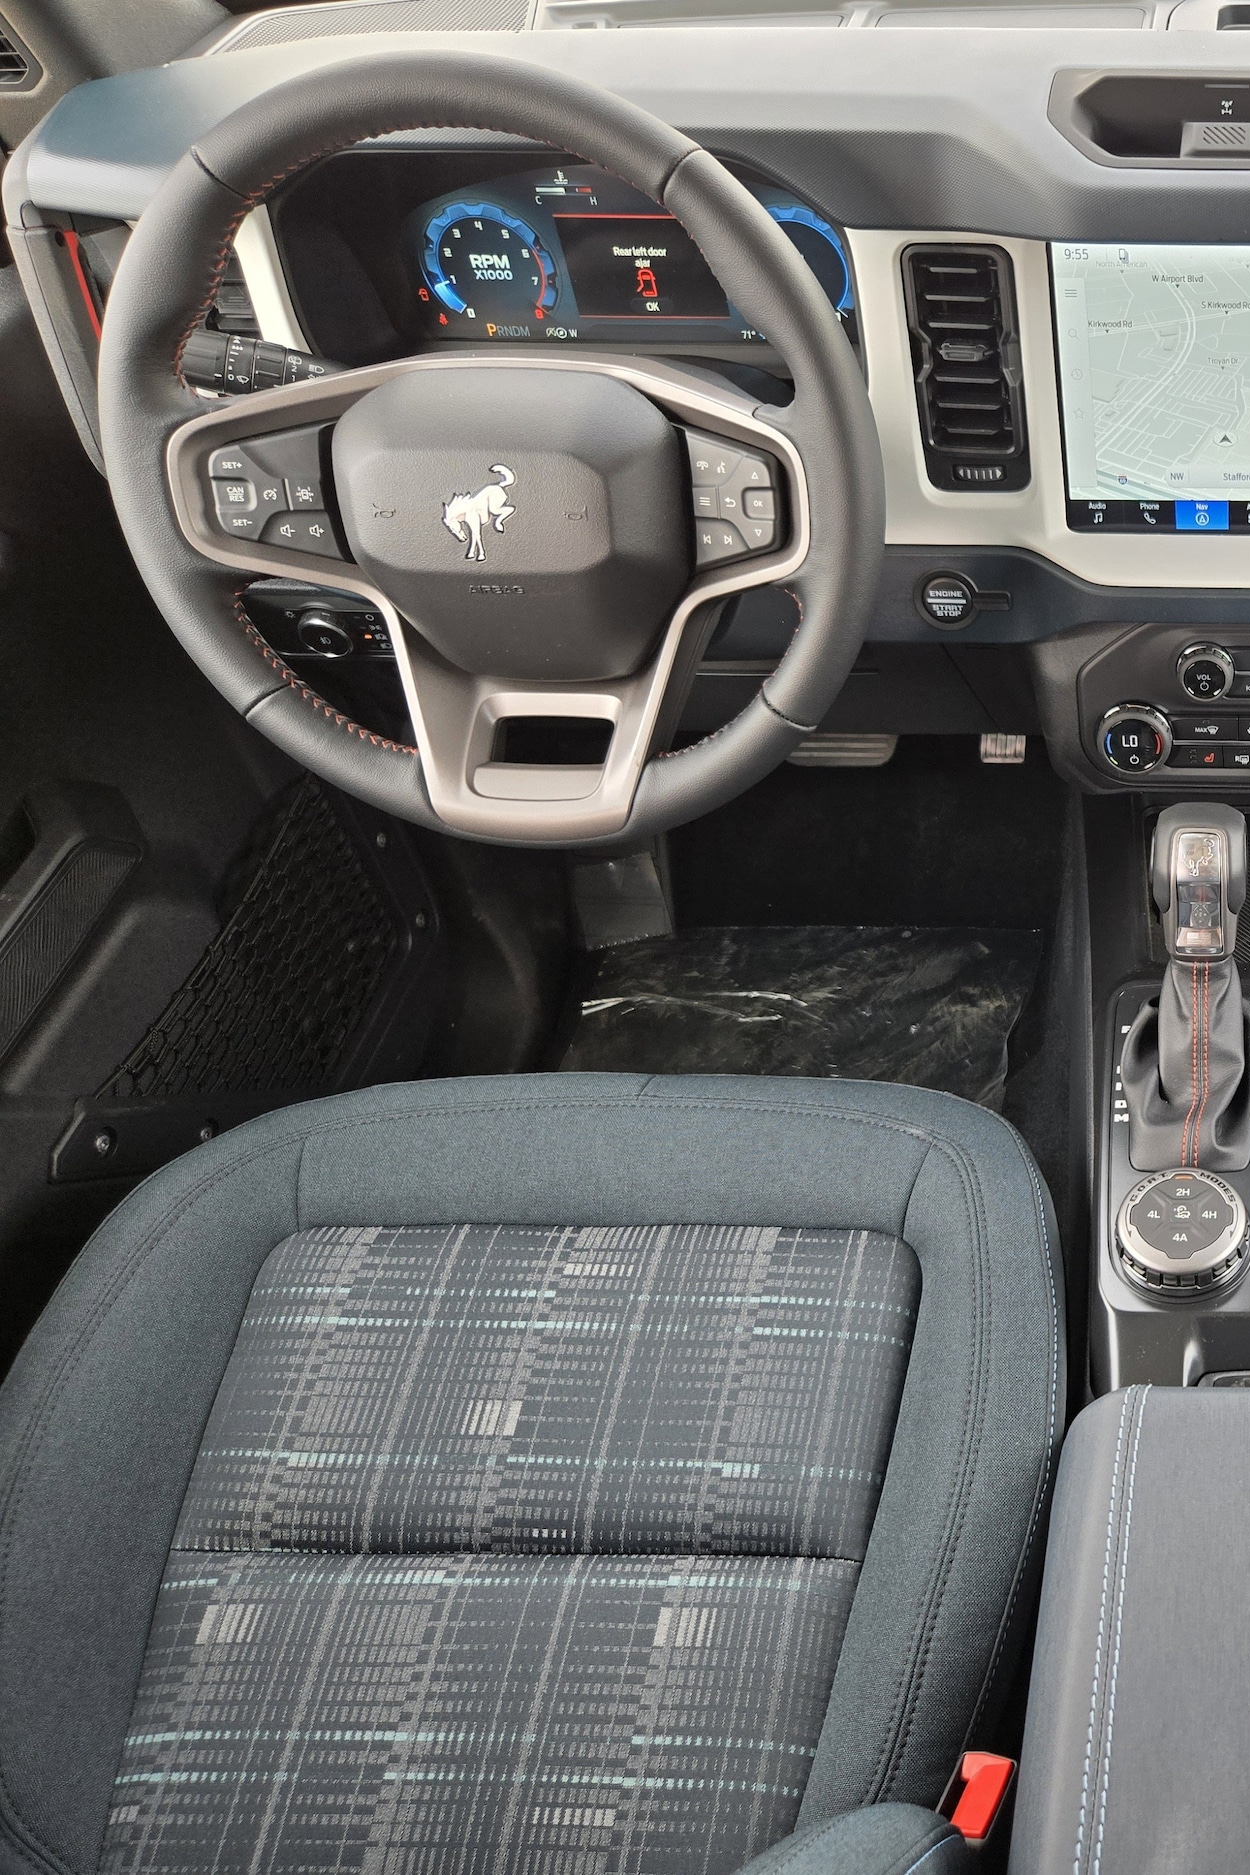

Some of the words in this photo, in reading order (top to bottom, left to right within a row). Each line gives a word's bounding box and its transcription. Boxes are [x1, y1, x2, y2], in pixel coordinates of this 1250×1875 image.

[535, 196, 542, 205] C
[589, 197, 598, 206] H
[474, 221, 483, 231] 4
[452, 228, 461, 239] 3
[501, 229, 510, 239] 5
[443, 248, 452, 257] 2
[521, 249, 530, 259] 6
[612, 246, 632, 257] Rear
[632, 247, 648, 257] left
[648, 247, 667, 257] door
[1064, 249, 1089, 260] 9:55
[469, 254, 511, 269] RPM
[634, 258, 650, 268] ajar
[474, 269, 513, 280] X1000
[1160, 274, 1186, 284] Airport
[1187, 275, 1204, 283] Blvd
[450, 275, 457, 284] 1
[532, 276, 539, 286] 7
[646, 303, 660, 311] OK
[1201, 301, 1206, 309] S
[1207, 301, 1240, 309] Kirkwood
[466, 308, 476, 319] 0
[535, 309, 544, 319] 8
[1088, 320, 1121, 328] Kirkwood
[1122, 320, 1133, 328] Rd
[568, 329, 578, 337] W
[1207, 357, 1231, 366] Troyan
[1170, 473, 1184, 481] NW
[1140, 503, 1160, 511] Phone
[929, 590, 963, 598] ENGINE
[1114, 1114, 1129, 1122] M
[1199, 1172, 1236, 1202] MODES
[1147, 1210, 1160, 1218] 4L
[1201, 1211, 1217, 1219] 4H
[1172, 1233, 1188, 1242] 4A
